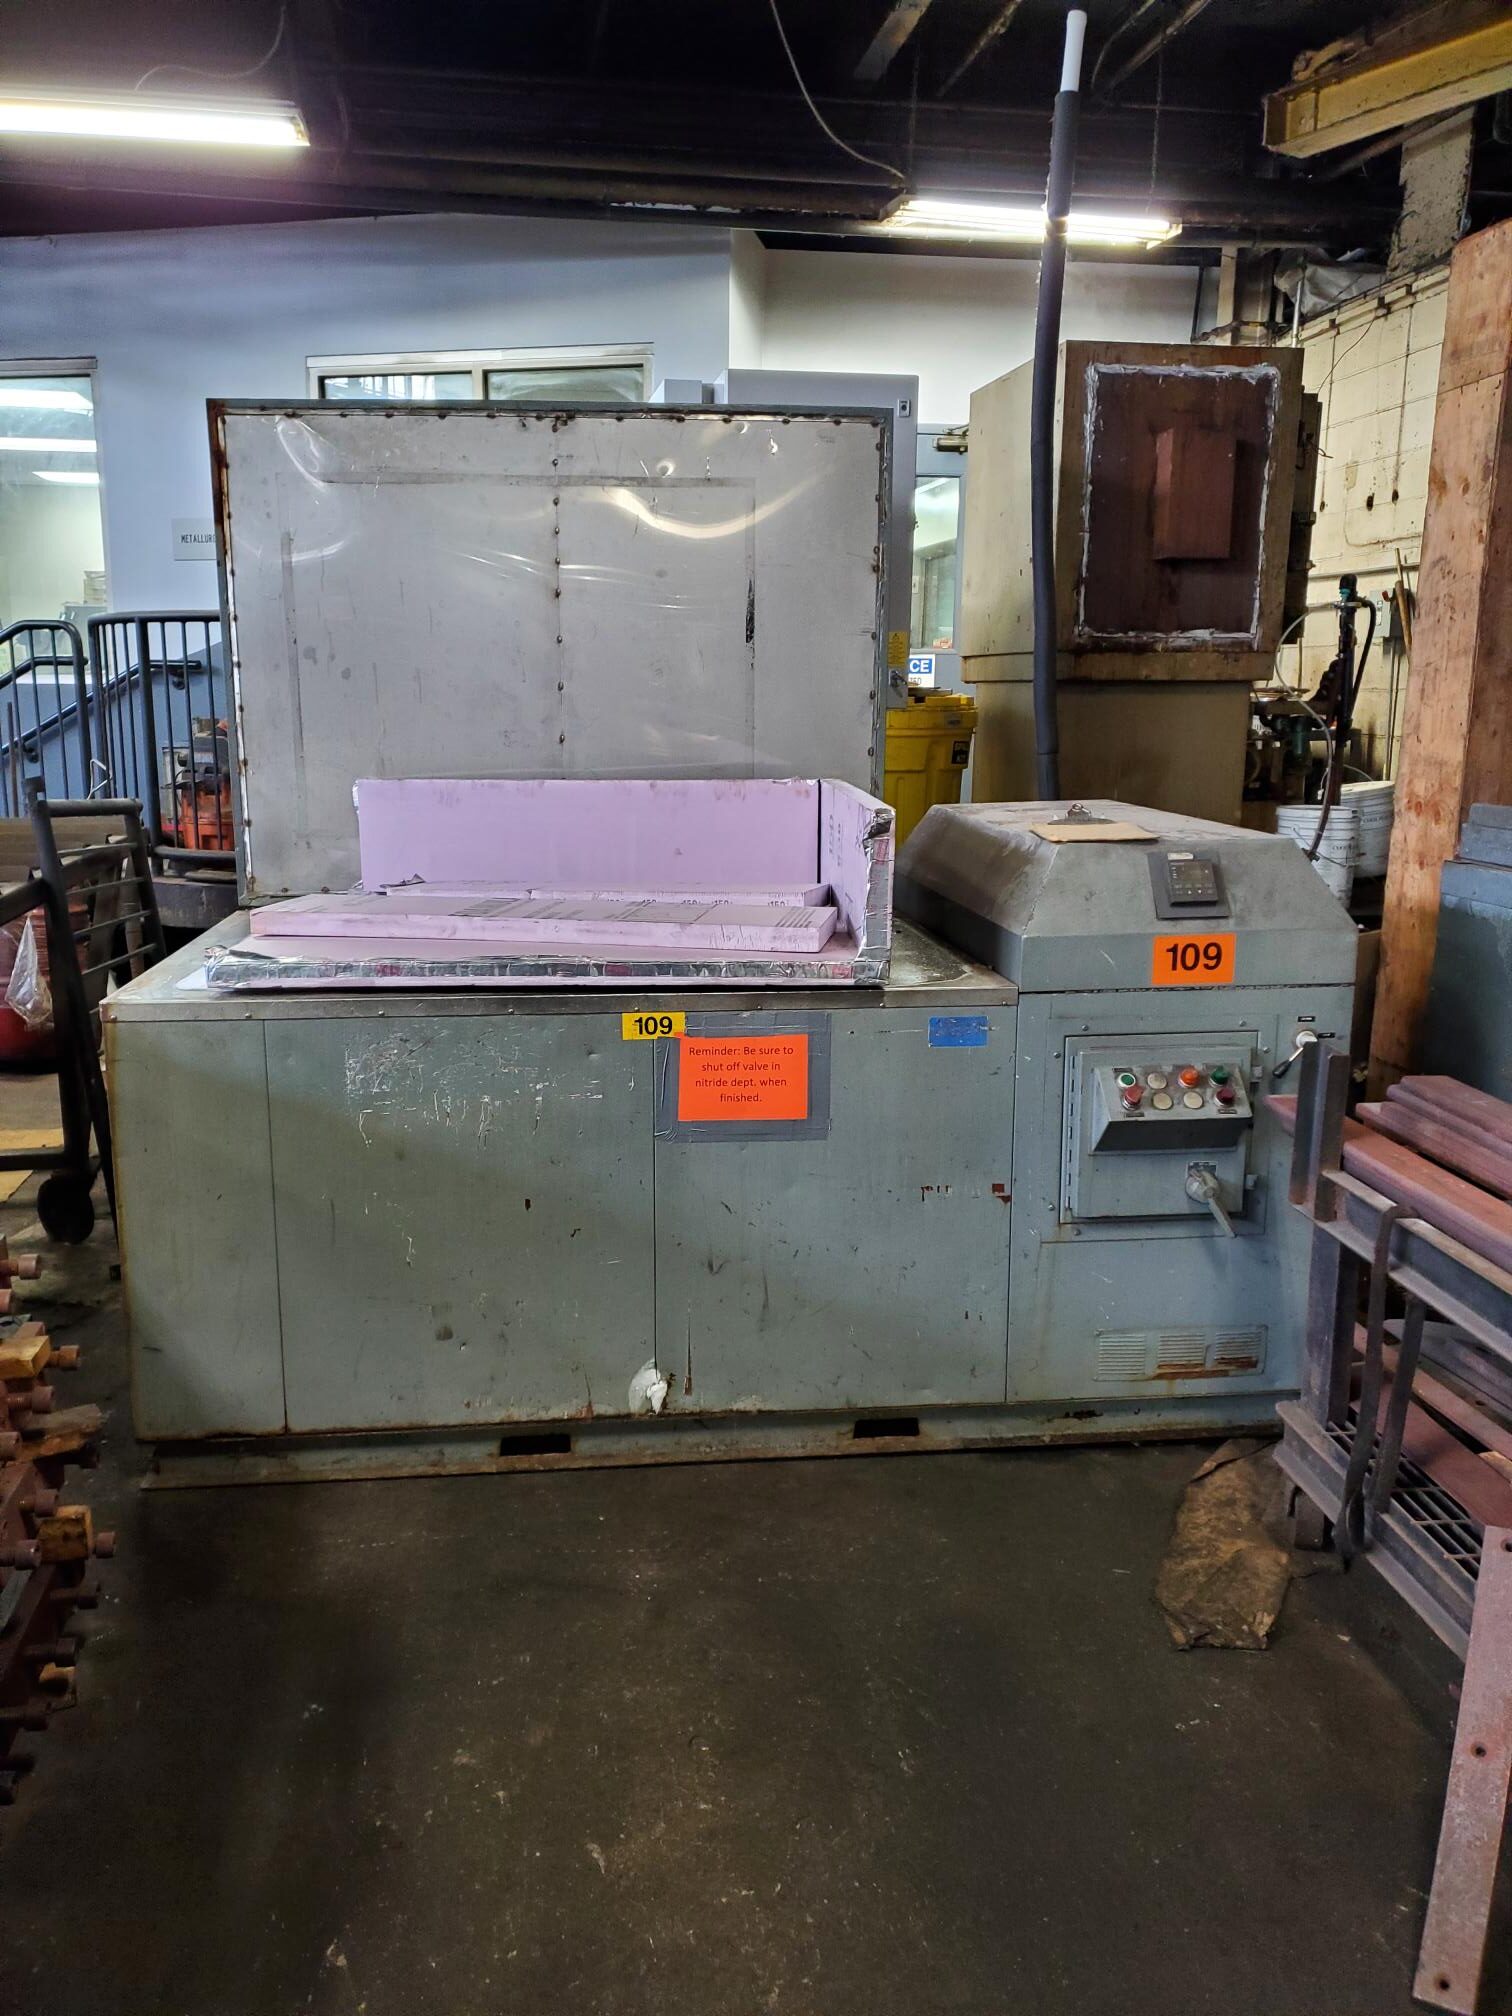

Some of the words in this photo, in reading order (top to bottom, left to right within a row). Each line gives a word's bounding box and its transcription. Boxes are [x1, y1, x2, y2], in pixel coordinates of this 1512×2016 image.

[1166, 942, 1222, 971] 109
[634, 1015, 673, 1035] 109
[689, 1046, 741, 1056] Reminder:
[743, 1046, 756, 1056] Be
[758, 1047, 782, 1055] sure
[783, 1046, 794, 1055] to
[701, 1062, 724, 1072] shut
[726, 1061, 741, 1071] off
[743, 1061, 769, 1071] valve
[771, 1062, 781, 1071] in
[695, 1077, 729, 1087] nitride
[730, 1076, 757, 1088] dept.
[760, 1077, 787, 1087] when
[720, 1093, 763, 1103] finished.
